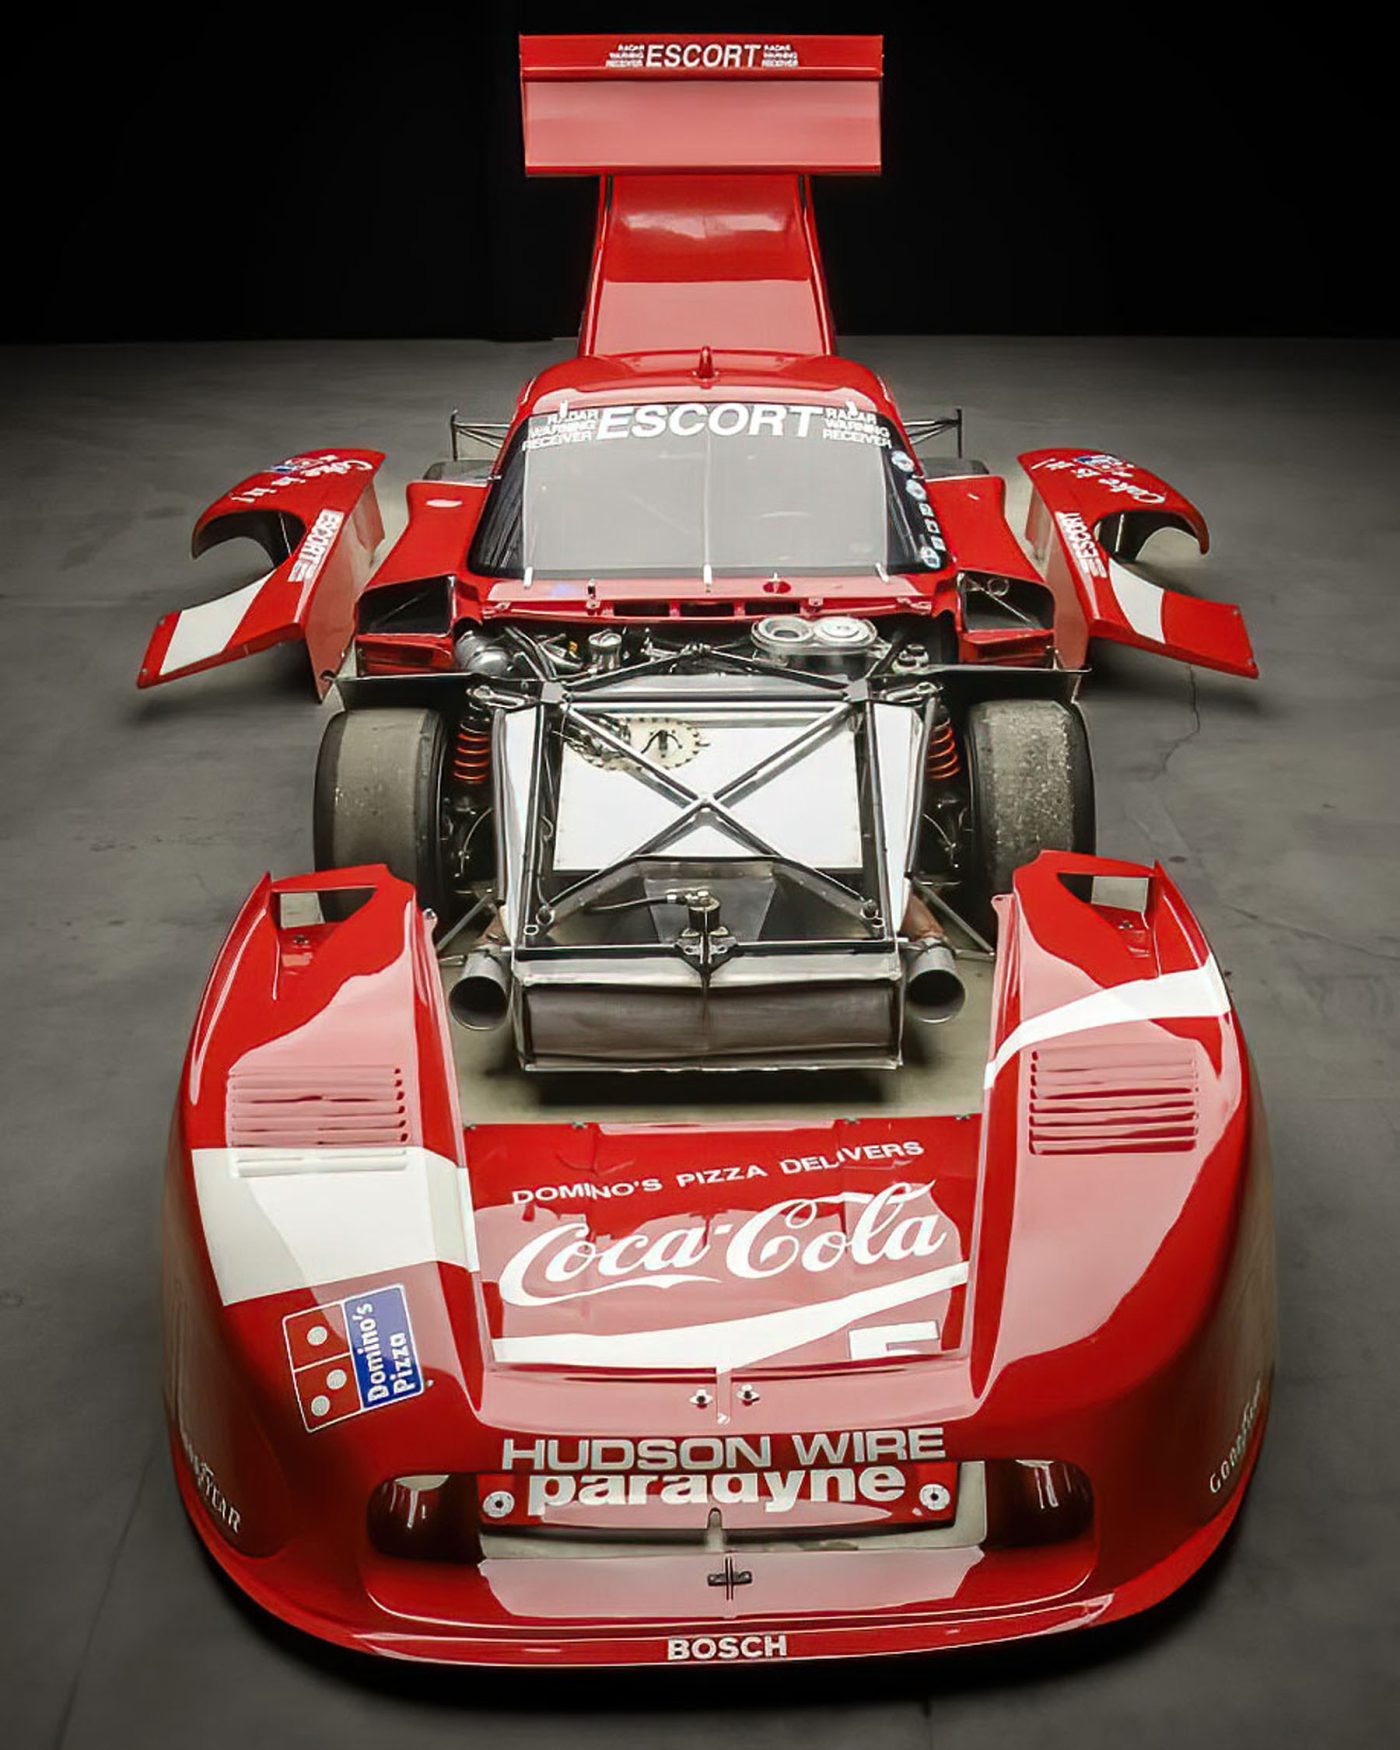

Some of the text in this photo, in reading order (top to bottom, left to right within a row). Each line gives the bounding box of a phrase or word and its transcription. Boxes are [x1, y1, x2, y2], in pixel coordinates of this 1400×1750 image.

[646, 44, 762, 68] ESCORT
[529, 419, 597, 439] WARNING
[596, 403, 824, 440] ESCORT
[823, 429, 893, 449] RECEIVER
[825, 418, 891, 438] WARNING
[522, 431, 592, 451] RECEIVER
[511, 1141, 925, 1206] DOMINO'S PIZZA DELIVERS
[500, 1180, 948, 1307] Coca-Cola
[352, 1303, 389, 1402] Domino's
[389, 1333, 416, 1395] Pizza
[502, 1427, 946, 1471] HUDSON WIRE
[528, 1465, 907, 1517] paradyne
[667, 1634, 788, 1661] BOSCH
